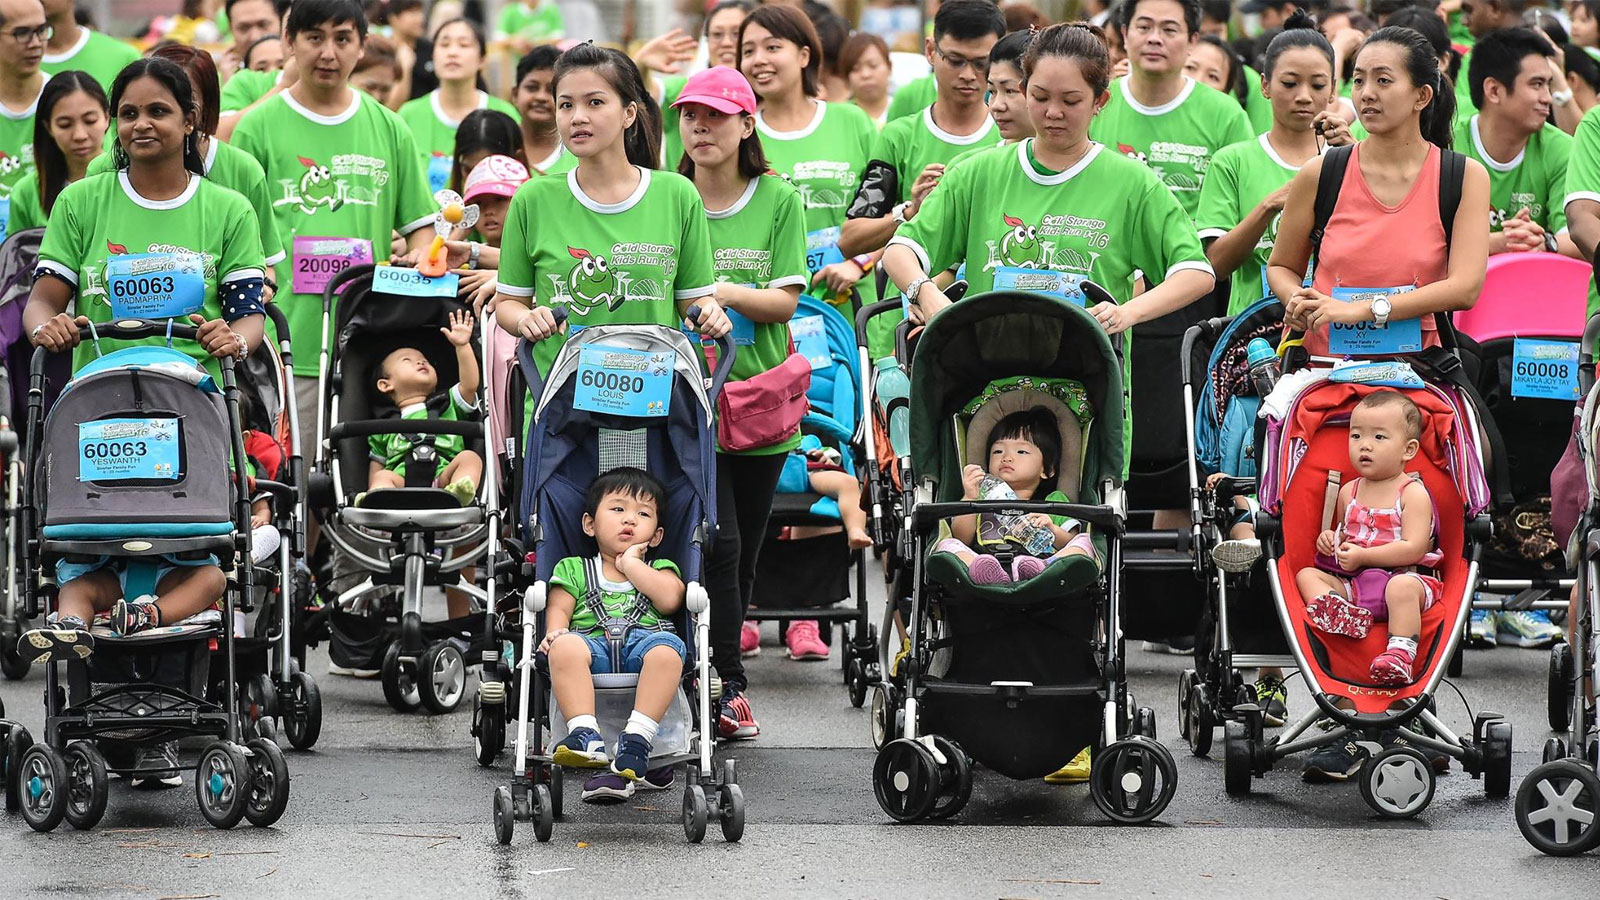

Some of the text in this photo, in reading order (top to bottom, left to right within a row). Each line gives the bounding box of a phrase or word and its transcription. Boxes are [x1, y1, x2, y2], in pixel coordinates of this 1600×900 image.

[1042, 214, 1105, 229] Cold Storage
[1038, 226, 1061, 236] Kids
[1062, 226, 1081, 236] Run
[148, 243, 176, 254] Cold
[611, 243, 675, 256] Cold Storage
[610, 254, 635, 265] Kids
[638, 255, 658, 265] Run
[715, 249, 769, 260] Cold Storage
[299, 258, 350, 273] 20098
[715, 260, 734, 270] Kids
[736, 260, 755, 270] Run
[379, 269, 432, 285] 60035
[113, 276, 175, 297] 60063
[118, 294, 173, 305] PADMAPRIYA
[1517, 361, 1568, 379] 60008
[581, 369, 644, 393] 60080
[1514, 376, 1542, 384] MIKAYLA
[1558, 378, 1569, 386] TAY
[598, 389, 625, 400] LOUIS
[84, 441, 147, 458] 60063
[91, 457, 140, 465] YESWANTH
[1348, 685, 1398, 697] Quinny
